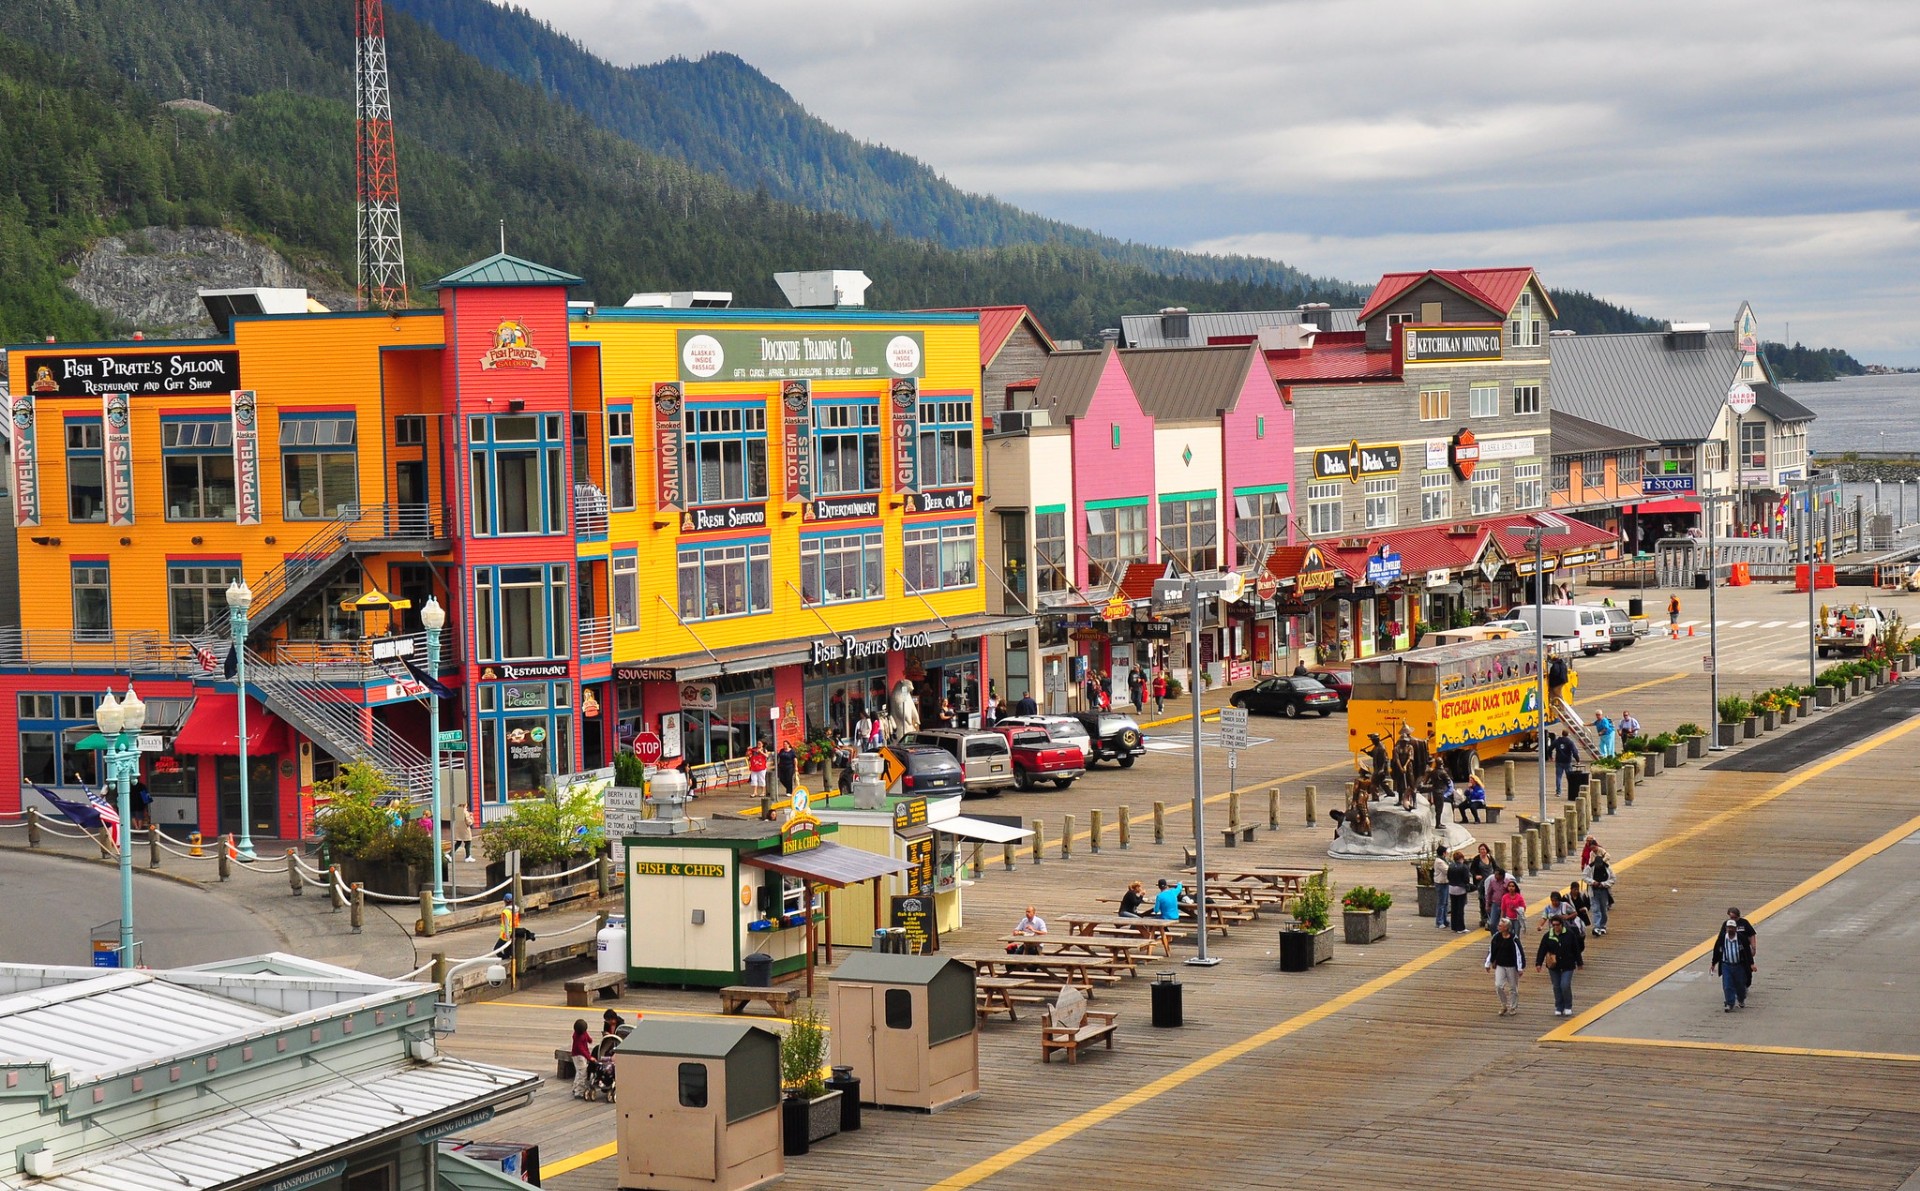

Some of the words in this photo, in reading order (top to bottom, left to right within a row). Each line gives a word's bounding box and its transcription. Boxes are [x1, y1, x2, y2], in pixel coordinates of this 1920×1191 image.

[489, 349, 507, 360] FISH
[761, 337, 800, 364] DOCKSIDE
[803, 337, 838, 360] TRADING
[840, 337, 854, 360] CO.
[1417, 337, 1461, 353] KETCHIKAN
[1461, 336, 1489, 352] MINING
[1489, 336, 1500, 351] CO.
[63, 358, 93, 379] FISH
[98, 357, 163, 378] PIRATE'S
[170, 355, 225, 376] SALOON
[733, 368, 746, 377] GIFTS
[768, 368, 786, 376] APPAREL
[863, 366, 879, 375] GALLERY
[82, 380, 140, 396] RESTAURANT
[143, 381, 160, 391] AND
[164, 377, 185, 391] GIFT
[189, 377, 212, 390] SHOP
[656, 421, 681, 429] Smoked
[784, 417, 809, 425] Alaskan
[787, 433, 798, 487] TOTEM
[799, 436, 809, 486] POLES
[898, 423, 913, 484] GIFTS
[17, 435, 36, 516] JEWELRY
[661, 432, 679, 501] SALMON
[114, 445, 129, 515] GIFTS
[240, 440, 256, 516] APPAREL
[1655, 480, 1691, 489] STORE
[818, 501, 877, 518] ENTERTAINMENT
[922, 492, 944, 511] BEER
[945, 495, 956, 505] ON
[957, 491, 972, 508] TAP
[697, 510, 725, 530] FRESH
[728, 507, 764, 527] SEAFOOD
[1293, 570, 1335, 597] KLASSIQUE
[1106, 604, 1127, 618] Dynasty
[813, 640, 836, 665] FISH
[843, 635, 888, 660] PIRATES
[893, 627, 932, 651] SALOON
[1076, 632, 1101, 640] Dynasty
[501, 664, 567, 679] RESTAURANT
[617, 669, 672, 680] SOUVENIRS
[1441, 696, 1481, 720] KETCHIKAN
[1482, 692, 1500, 711] DUCK
[1502, 688, 1520, 706] TOUR
[438, 732, 454, 741] FRONT
[635, 742, 660, 754] STOP
[608, 790, 623, 798] BERTH
[783, 839, 797, 854] FISH
[798, 838, 803, 850] &
[803, 834, 821, 849] CHIPS
[638, 863, 667, 874] FISH
[671, 864, 680, 875] &
[684, 864, 723, 877] CHIPS
[424, 1121, 454, 1138] WALKING
[454, 1115, 473, 1129] TOUR
[472, 1111, 490, 1122] MAPS
[272, 1164, 335, 1191] TRANSPORTATION
